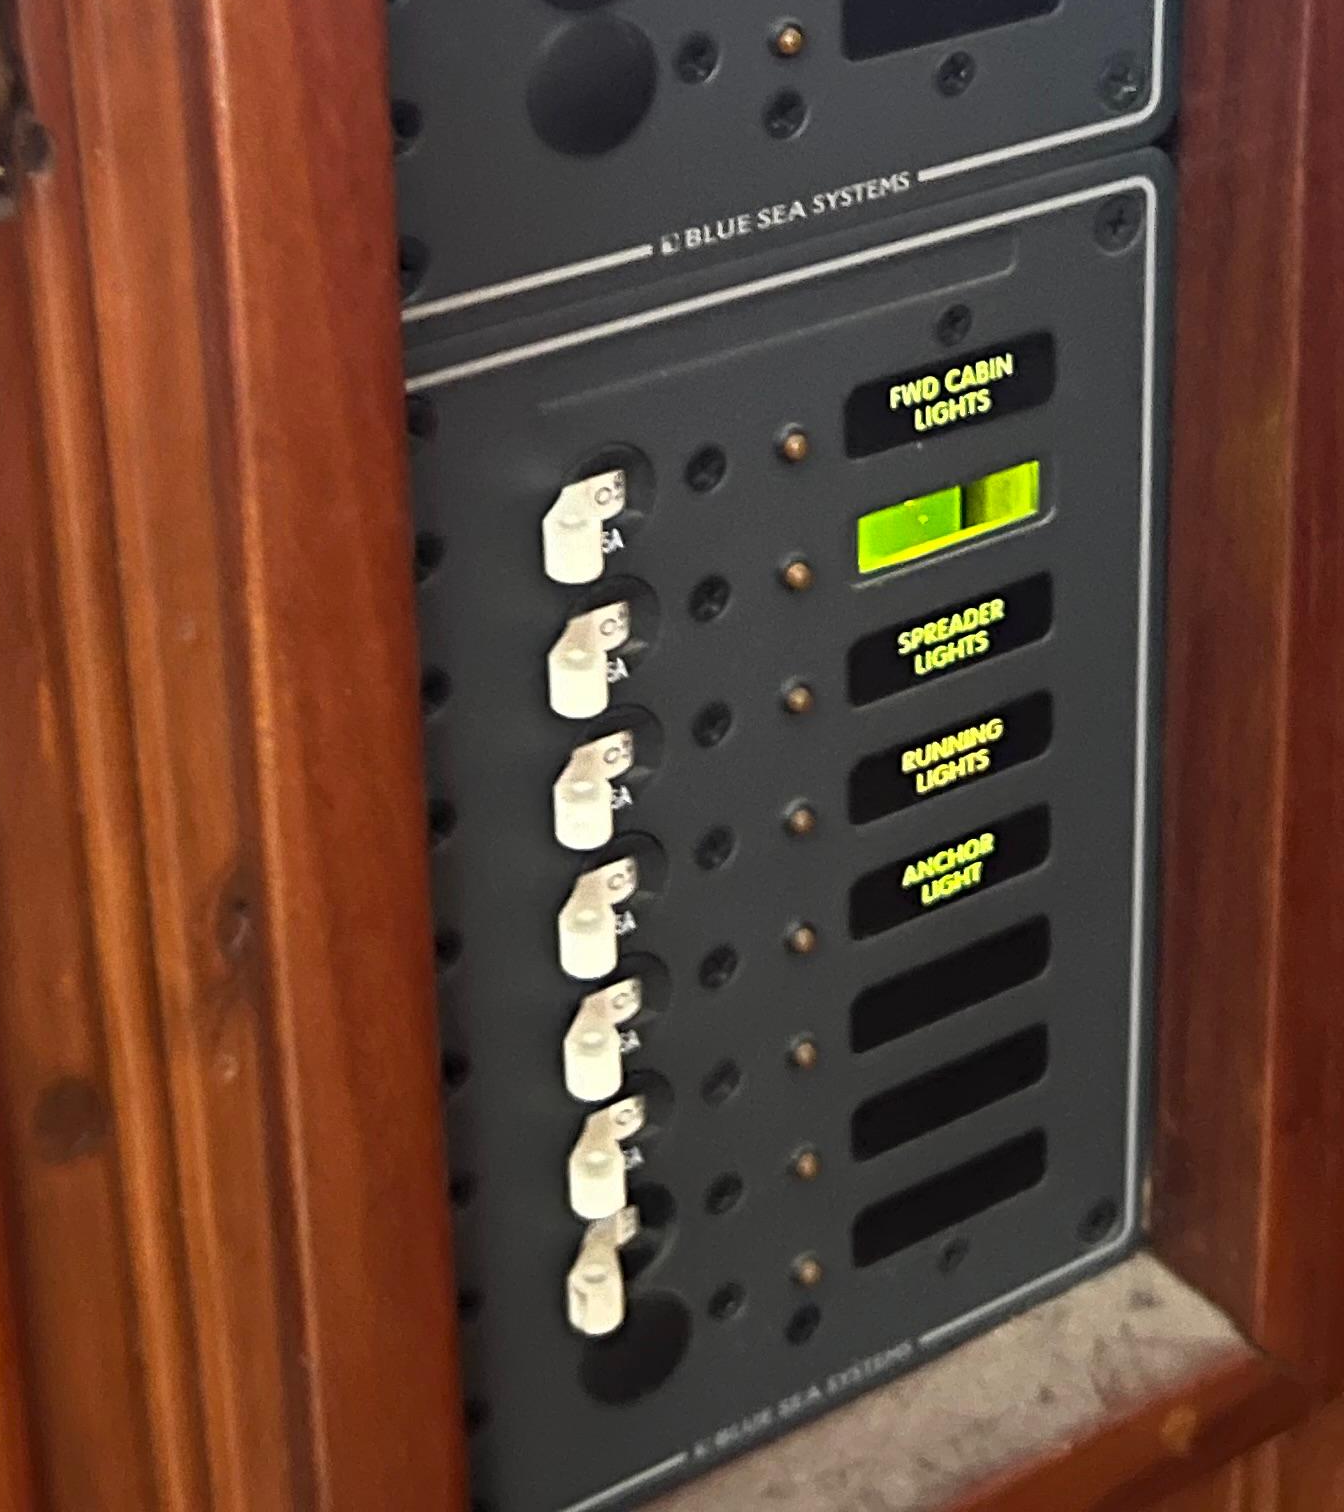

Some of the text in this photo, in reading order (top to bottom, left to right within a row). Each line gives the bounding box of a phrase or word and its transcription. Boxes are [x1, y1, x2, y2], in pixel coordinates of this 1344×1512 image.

[683, 170, 910, 249] BLUE SEA SYSTEMS
[889, 352, 1014, 410] FWD CABIN
[914, 388, 992, 432] LIGHTS
[896, 597, 1006, 655] SPREADER
[914, 629, 990, 676] LIGHTS
[901, 717, 1005, 773] RUNNING
[916, 747, 991, 794] LIGHTS
[901, 832, 995, 888] ANCHOR
[920, 860, 984, 905] LIGHT
